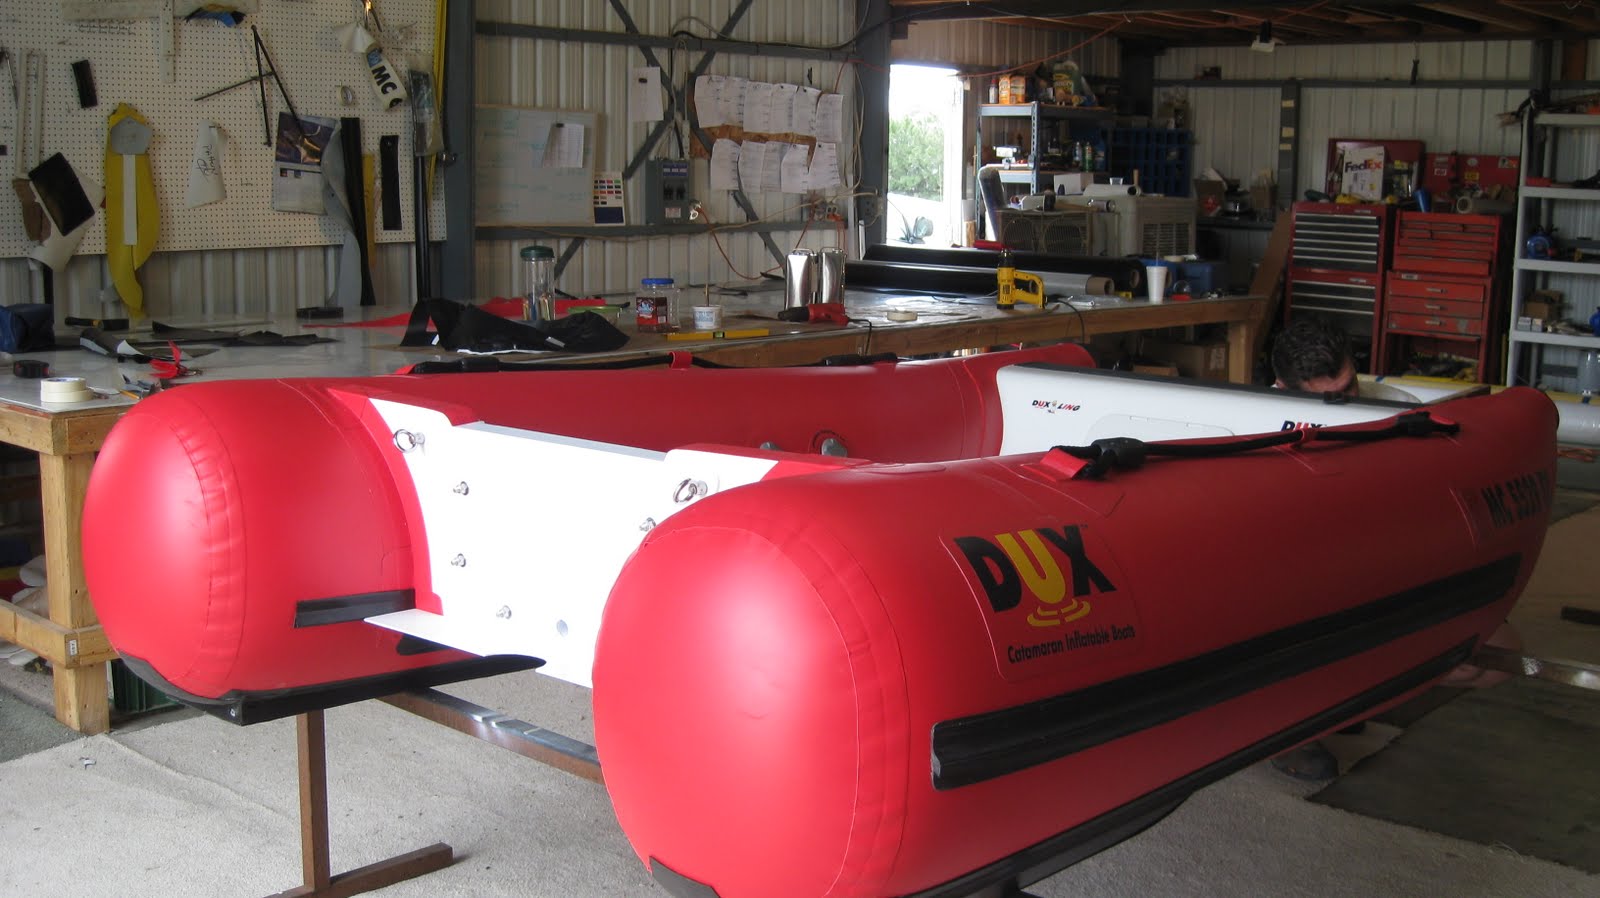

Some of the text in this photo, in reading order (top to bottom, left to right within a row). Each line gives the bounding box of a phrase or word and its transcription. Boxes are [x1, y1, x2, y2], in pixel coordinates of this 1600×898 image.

[371, 65, 398, 95] MC
[1344, 159, 1383, 173] FedEx
[1031, 399, 1081, 411] DUX LING
[953, 524, 1118, 613] DUX
[1007, 623, 1136, 664] Catamaran Inflatable Boats
